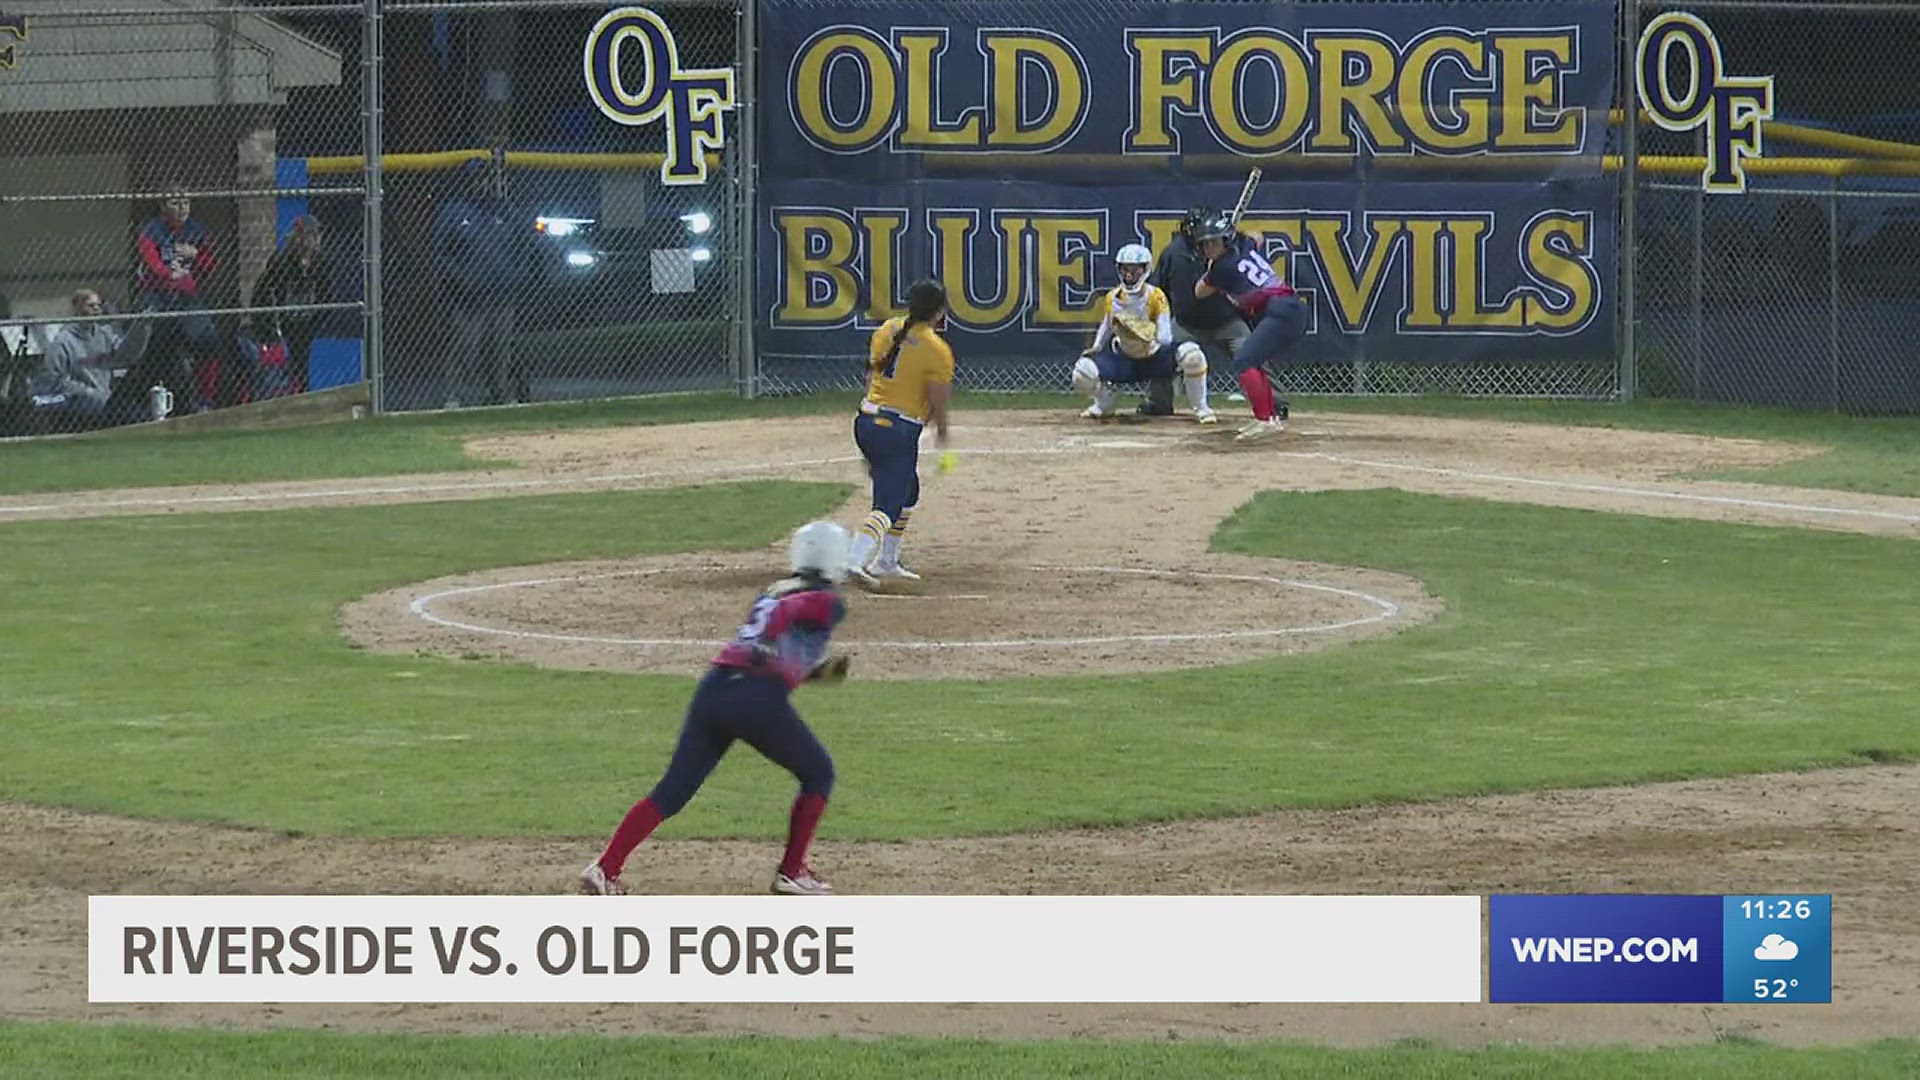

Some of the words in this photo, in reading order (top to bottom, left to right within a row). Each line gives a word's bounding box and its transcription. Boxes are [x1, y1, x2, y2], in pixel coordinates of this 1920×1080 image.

[787, 25, 1091, 155] OLD
[1122, 26, 1588, 157] FORGE
[770, 206, 1112, 334] BLUE
